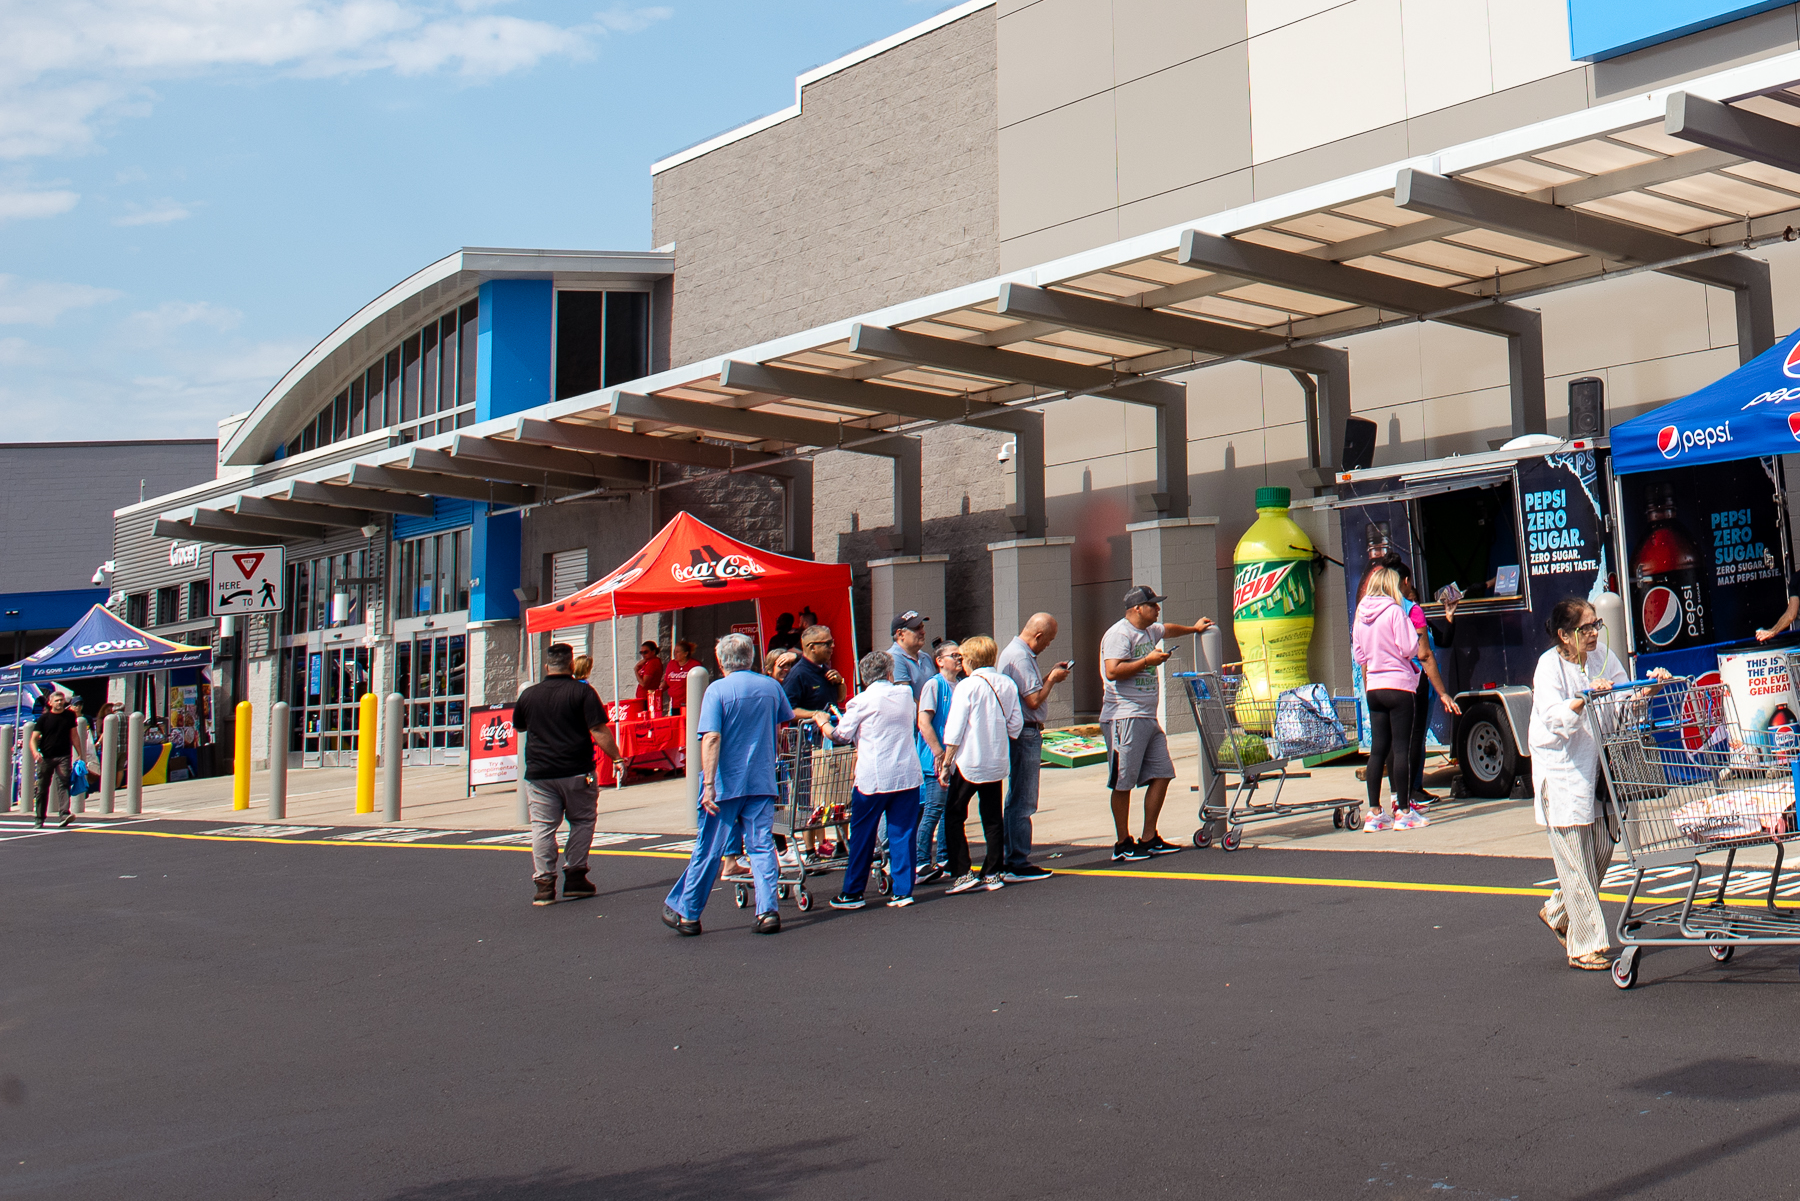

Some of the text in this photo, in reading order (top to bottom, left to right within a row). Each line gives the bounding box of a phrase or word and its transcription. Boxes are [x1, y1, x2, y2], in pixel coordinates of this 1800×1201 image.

[1683, 420, 1732, 453] pepsi
[1525, 489, 1566, 512] PEPSI
[1527, 509, 1567, 532] ZERO
[1711, 509, 1751, 529] PEPSI
[1529, 528, 1585, 551] SUGAR.
[1713, 527, 1752, 547] ZERO
[169, 541, 202, 569] Grocery
[1530, 549, 1580, 563] ZERO SUGAR.
[671, 555, 766, 583] Coca-Cola
[1531, 560, 1599, 575] MAX PEPSI TASTE.
[1716, 561, 1765, 575] ZERO SUGAR.
[219, 581, 241, 590] HERE
[1717, 568, 1781, 586] MAX PEPSI TASTE.
[243, 598, 254, 606] TO
[1681, 585, 1699, 636] pepsi
[77, 639, 144, 656] GOYA
[1746, 657, 1779, 668] THIS IS
[1747, 667, 1766, 677] THE
[1748, 677, 1767, 687] FOR
[473, 765, 518, 774] Complimentary
